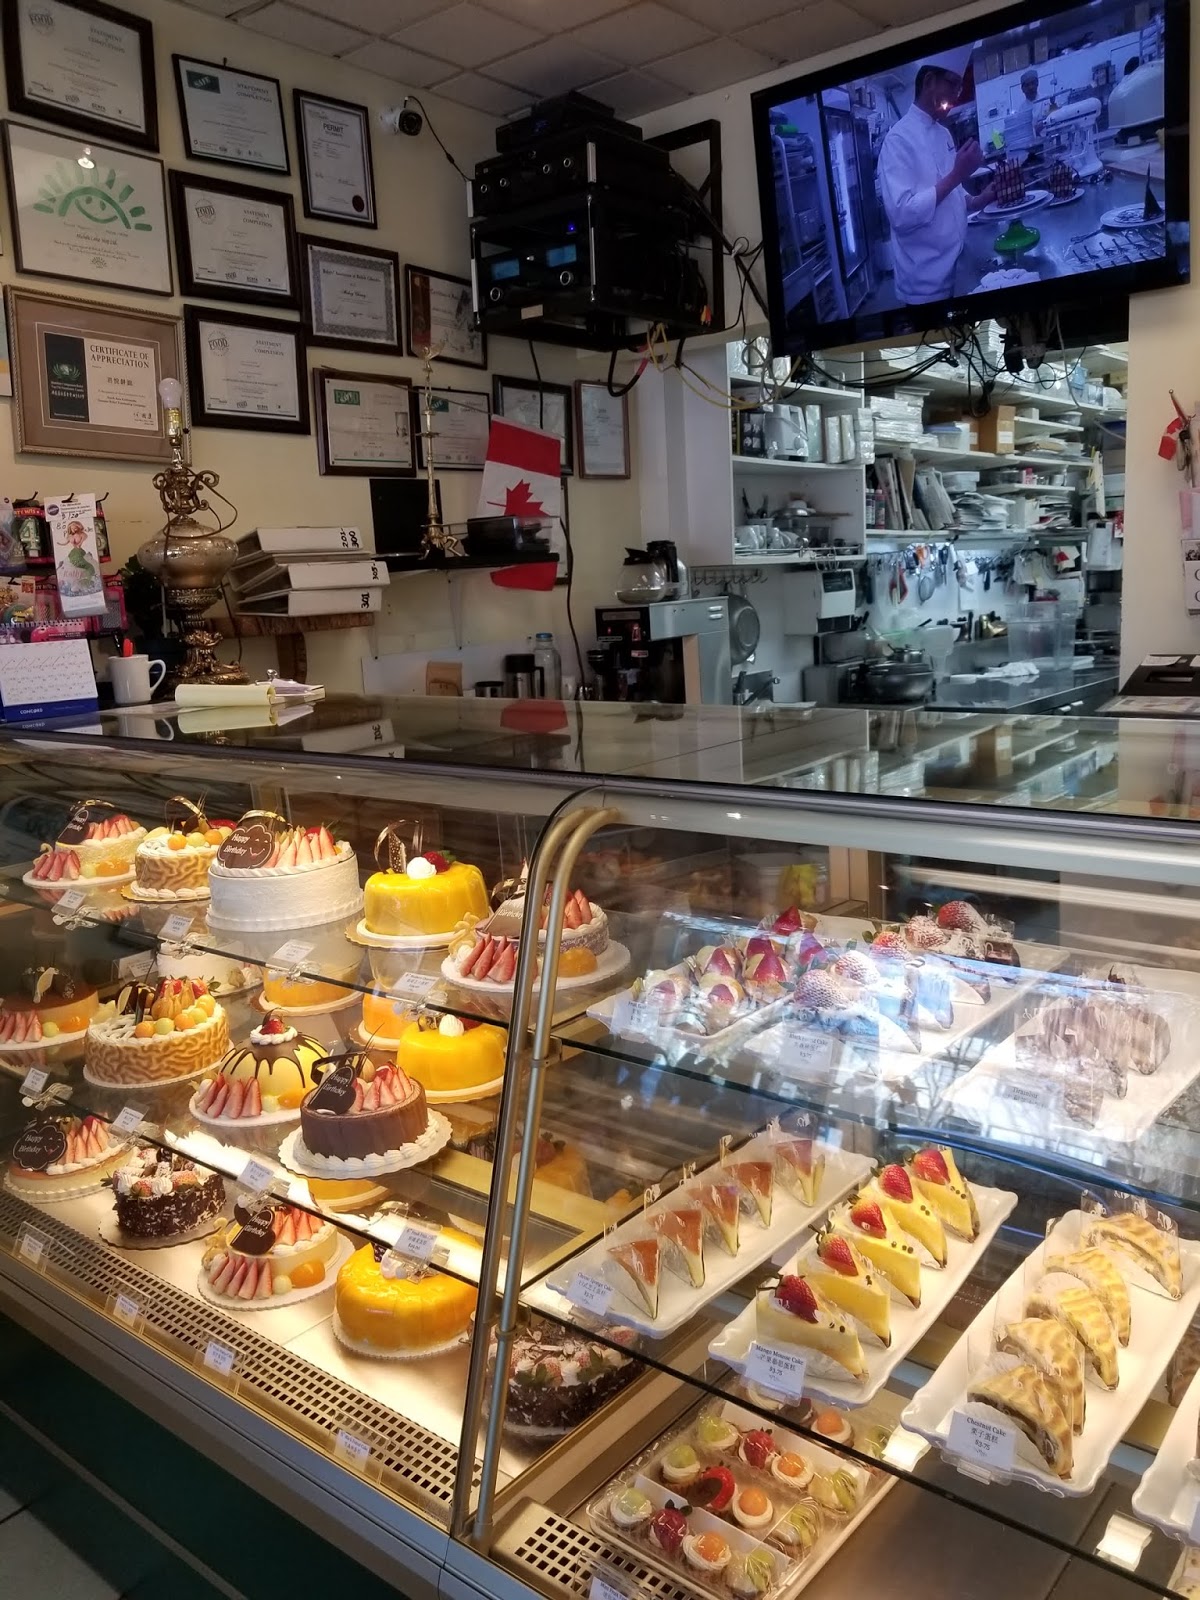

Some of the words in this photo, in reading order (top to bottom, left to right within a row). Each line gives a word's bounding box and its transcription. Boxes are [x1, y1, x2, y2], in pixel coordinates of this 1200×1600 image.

[322, 122, 344, 134] PERMIT
[90, 344, 138, 358] CERTIFICATE
[140, 352, 149, 361] OF
[91, 353, 150, 368] APPRECIATION
[348, 530, 359, 548] 300
[231, 833, 251, 844] Happy
[223, 845, 248, 857] Birthday
[330, 1073, 349, 1085] Happy
[323, 1083, 347, 1097] Birthday
[25, 1135, 43, 1144] Happy
[18, 1145, 42, 1154] Birthday
[252, 1216, 269, 1227] Happy
[756, 1344, 773, 1355] Mango
[773, 1350, 791, 1361] Mousse
[791, 1356, 804, 1366] Cake
[769, 1365, 783, 1376] $3.75
[966, 1416, 992, 1431] Chestnut
[992, 1426, 1007, 1438] Cake
[971, 1427, 999, 1444] 栗子蛋糕
[974, 1439, 991, 1451] $3.75
